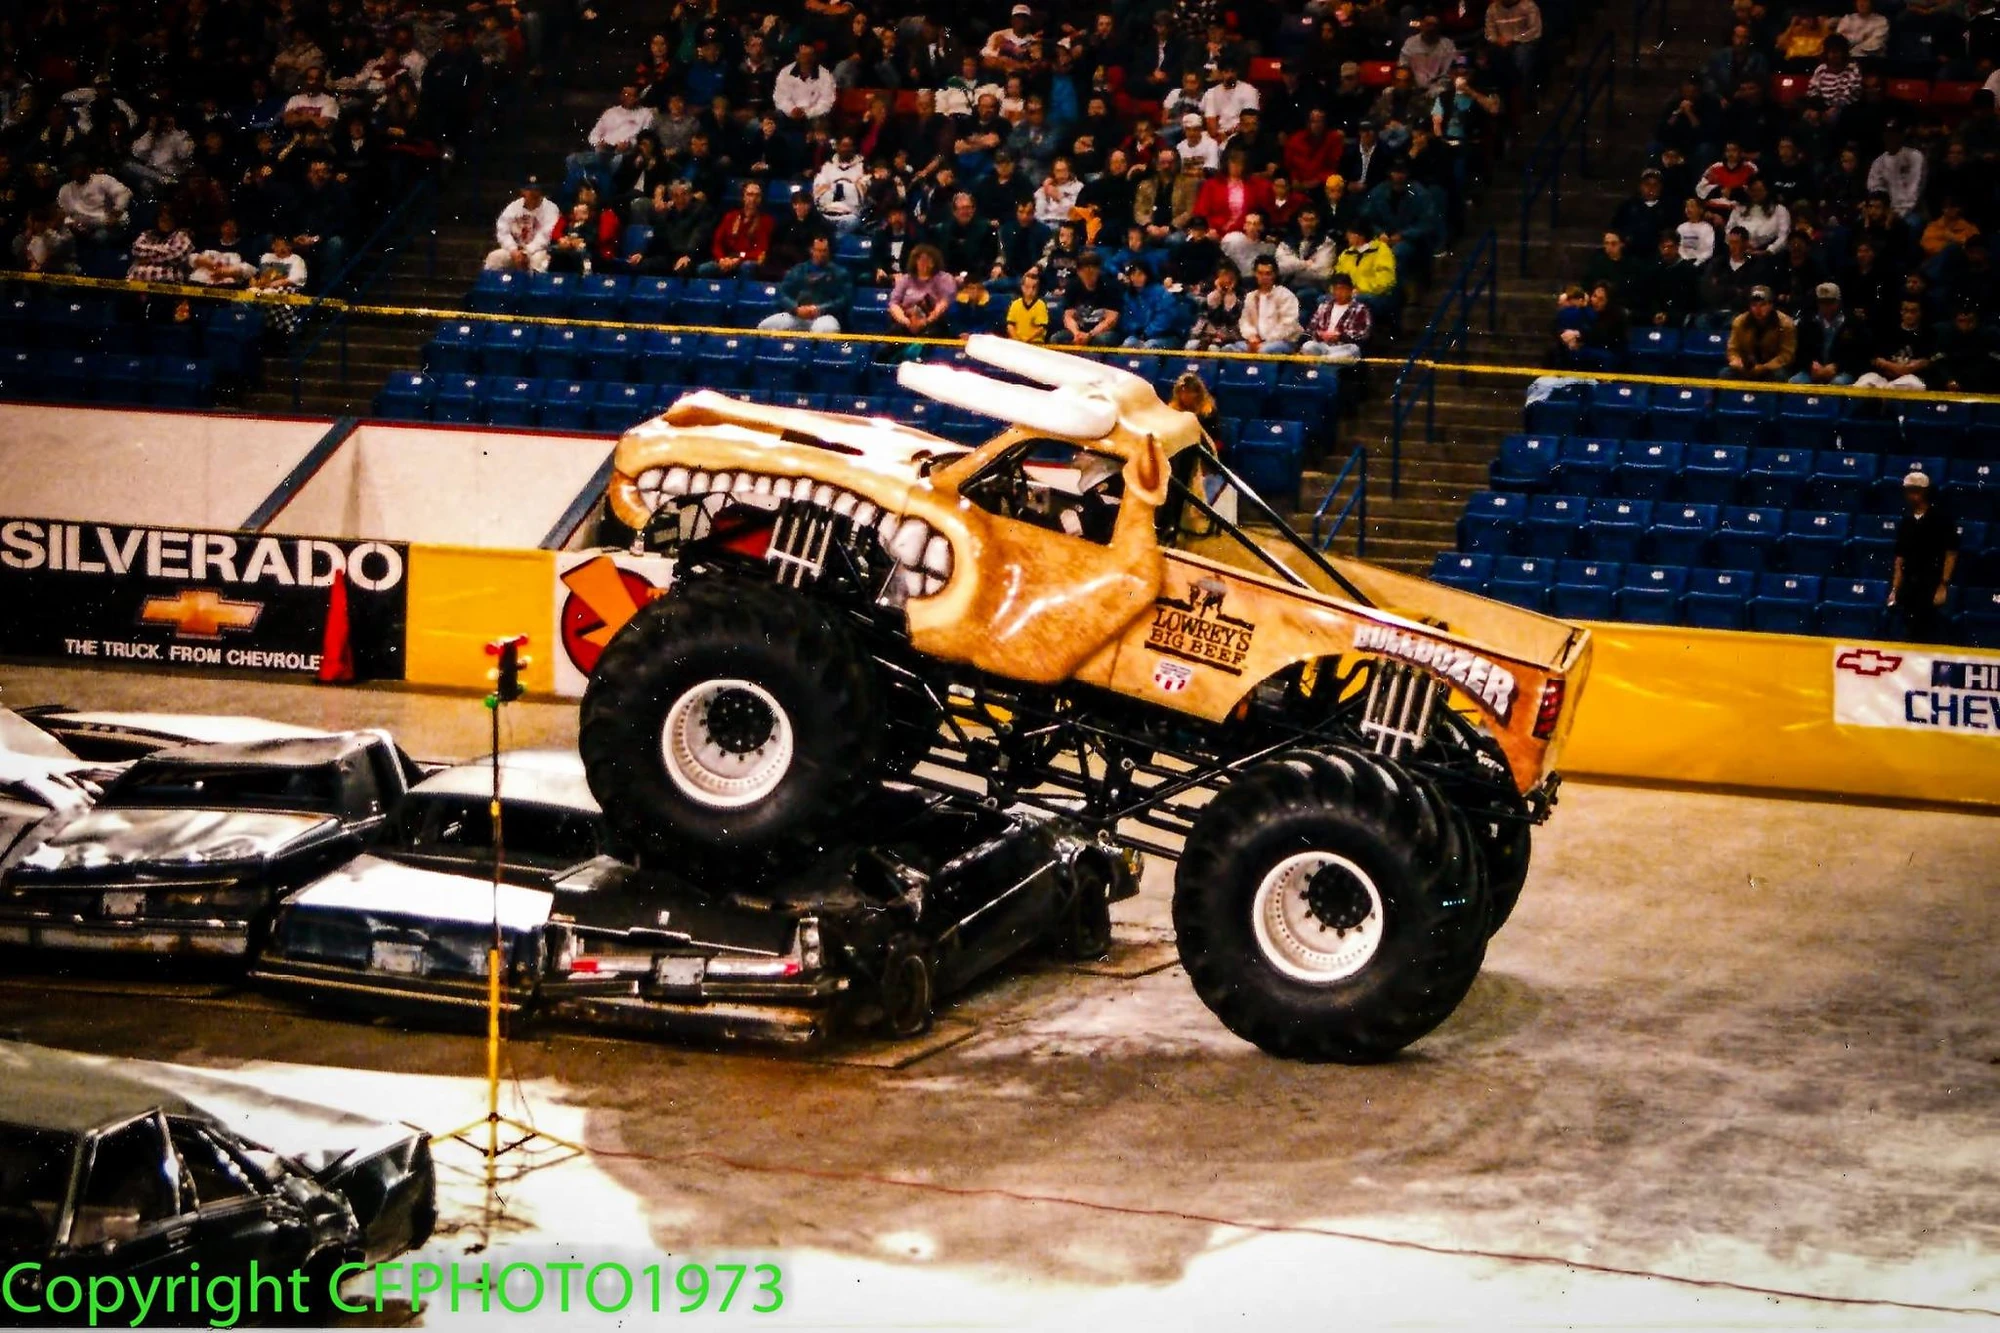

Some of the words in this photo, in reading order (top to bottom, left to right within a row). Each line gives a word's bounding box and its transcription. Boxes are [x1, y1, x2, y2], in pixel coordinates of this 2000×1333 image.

[1, 520, 403, 591] SILVERADO
[1150, 627, 1184, 649] BIG
[1189, 638, 1246, 665] BEEF
[1153, 607, 1253, 652] LOWREY'S
[65, 638, 98, 655] THE
[103, 641, 164, 660] TRUCK.
[169, 645, 221, 663] FROM
[226, 649, 325, 671] CHEVROLE
